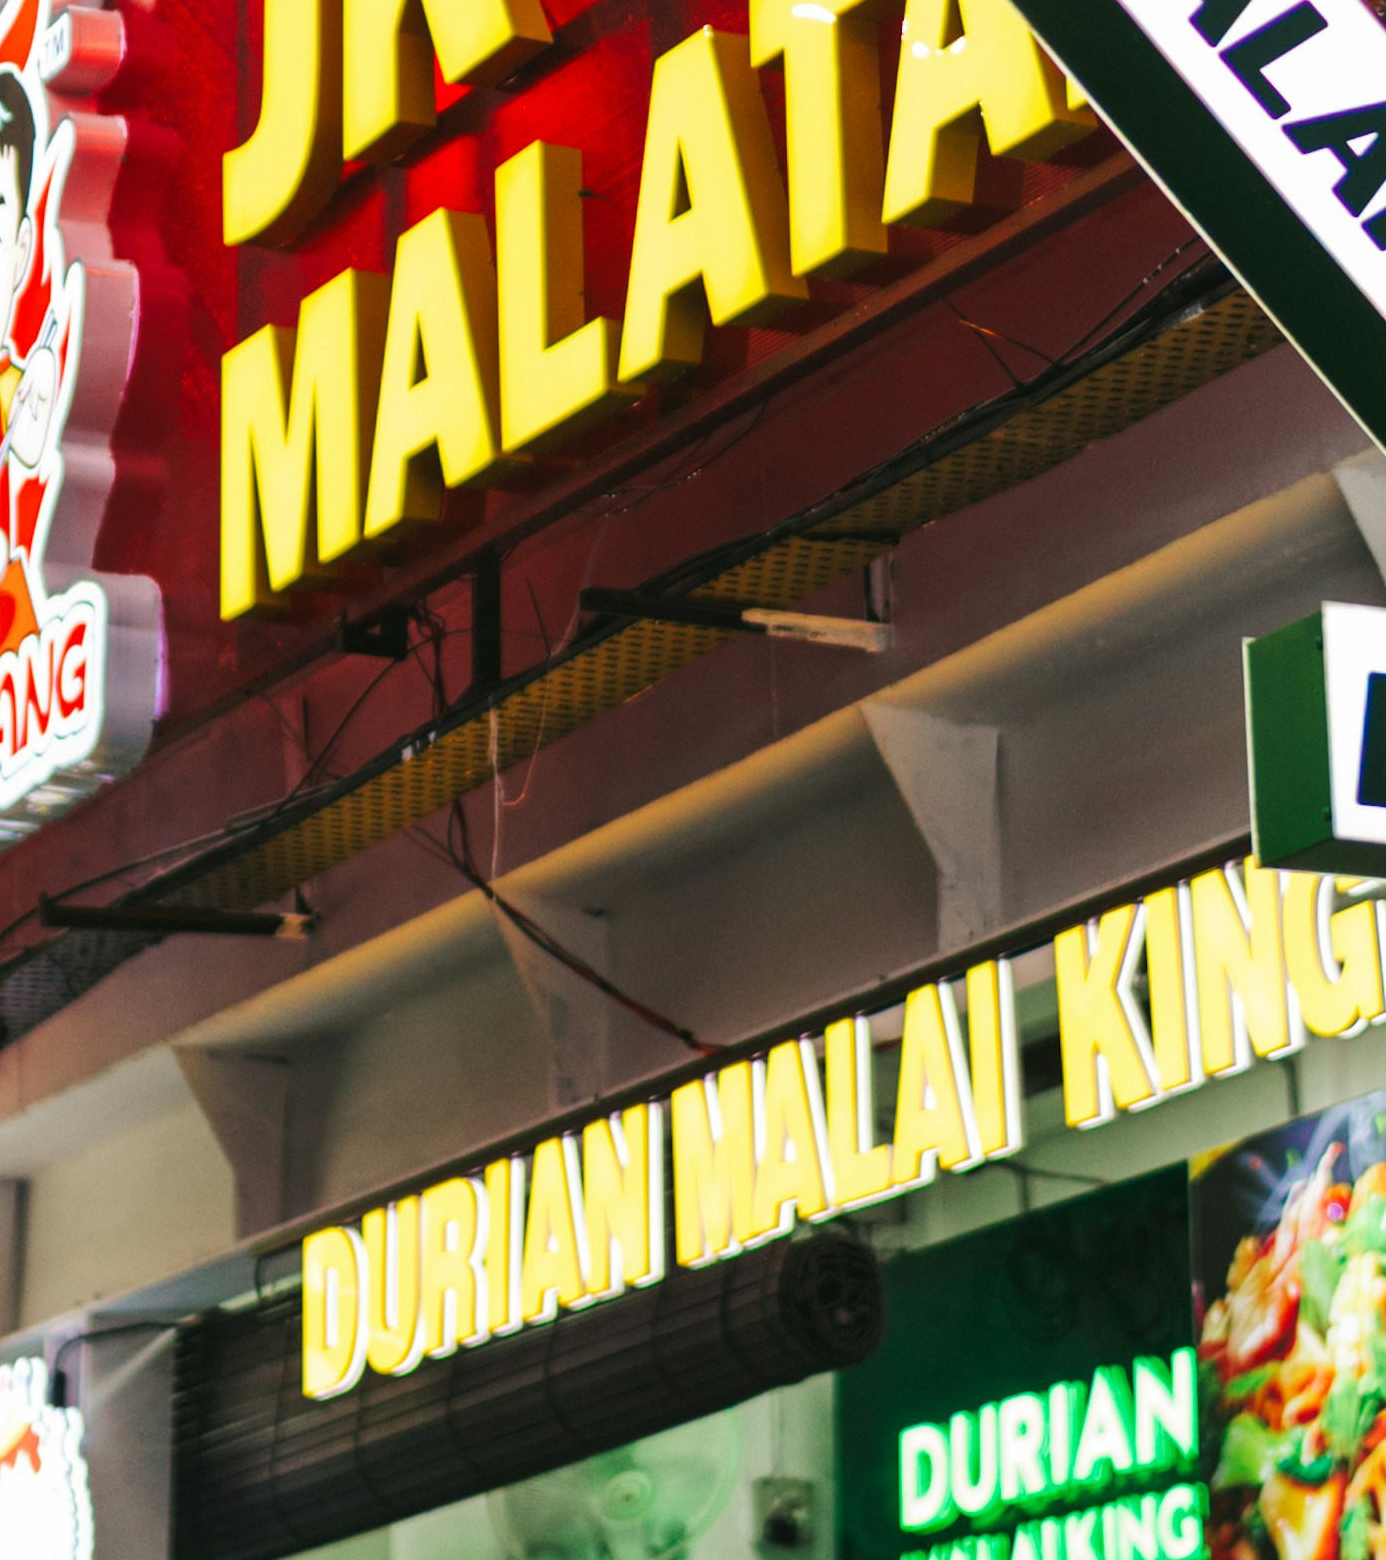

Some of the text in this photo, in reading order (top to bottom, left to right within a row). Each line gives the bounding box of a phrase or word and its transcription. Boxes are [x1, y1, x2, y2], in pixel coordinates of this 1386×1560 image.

[302, 1101, 666, 1402] DURIAN
[670, 955, 1025, 1270] MALAI
[898, 1345, 1200, 1533] DURIAN
